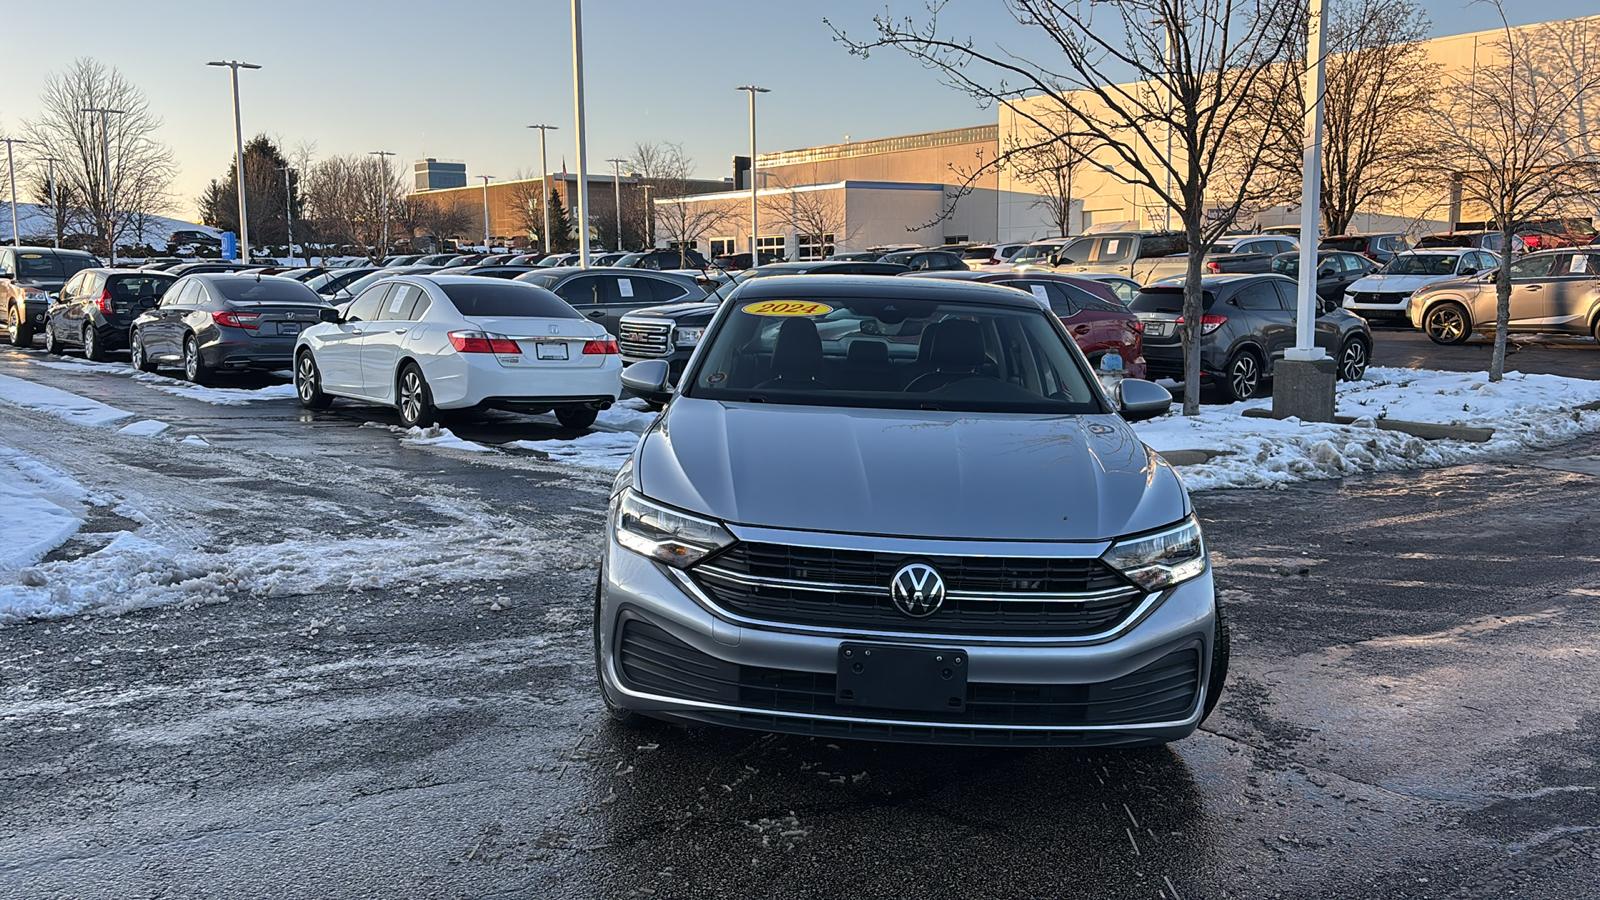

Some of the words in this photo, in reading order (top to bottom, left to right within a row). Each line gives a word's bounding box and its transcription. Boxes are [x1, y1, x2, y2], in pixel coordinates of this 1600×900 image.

[755, 303, 820, 313] 2024
[628, 332, 648, 342] GMC
[893, 565, 943, 613] VW
